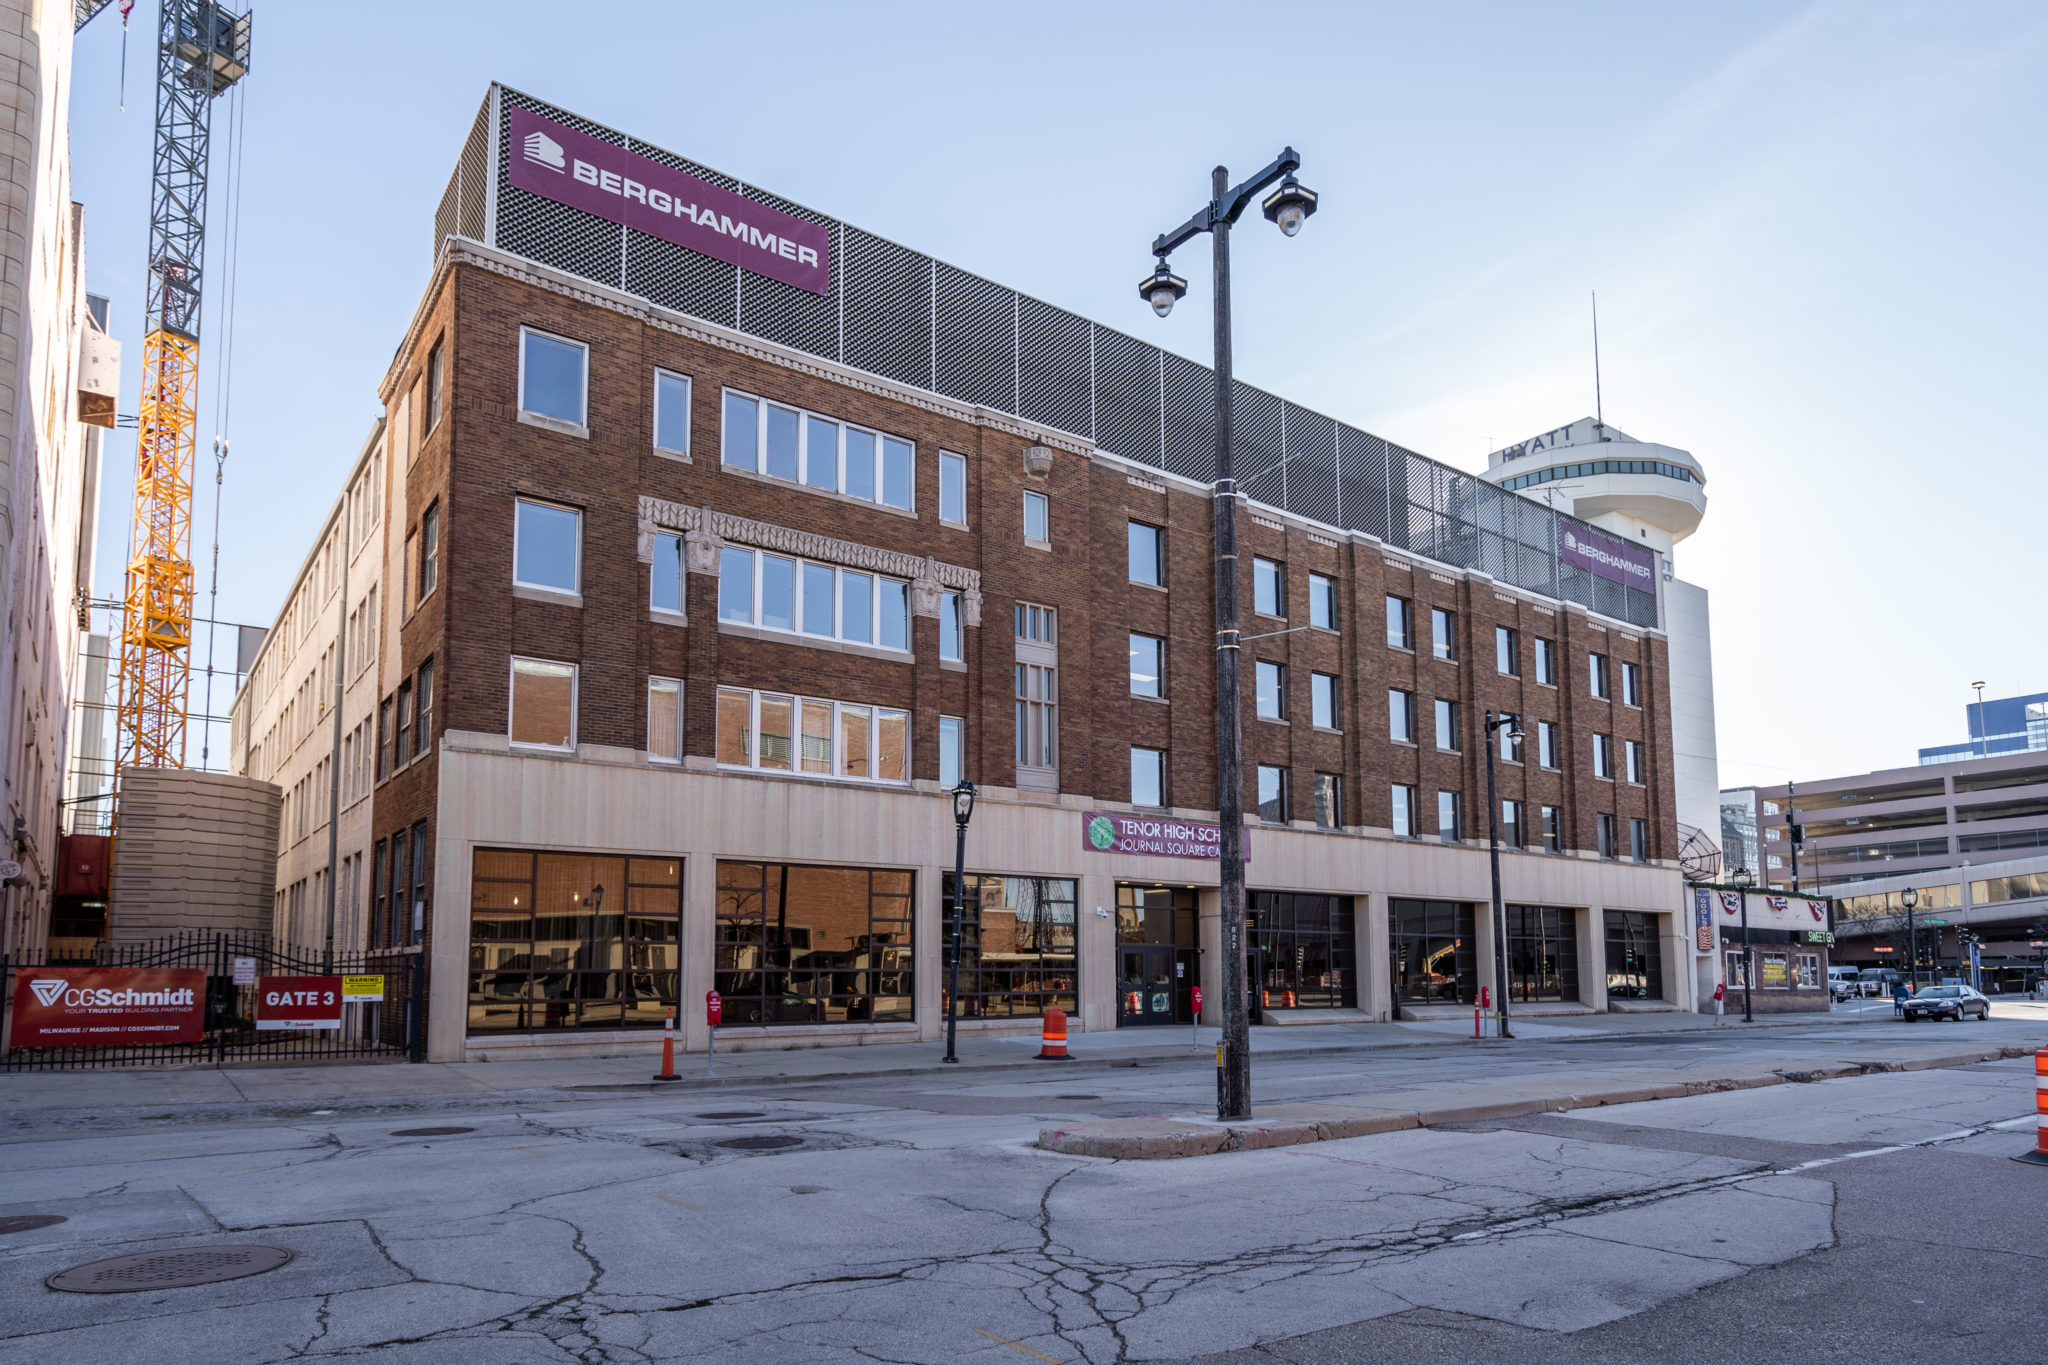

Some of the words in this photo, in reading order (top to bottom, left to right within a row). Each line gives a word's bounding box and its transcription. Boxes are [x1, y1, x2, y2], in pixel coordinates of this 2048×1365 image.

[573, 158, 818, 268] BERGHAMMER
[1502, 424, 1573, 463] HYATT
[1577, 542, 1651, 579] BERGHAMMER
[1120, 819, 1161, 838] TENOR
[1164, 824, 1195, 841] HIGH
[1198, 827, 1220, 843] SCH
[1119, 838, 1165, 855] JOURNAL
[1167, 843, 1206, 857] SQUARE
[1207, 845, 1220, 857] CA
[1808, 930, 1826, 943] SWEET
[64, 988, 194, 1007] CGSchmidt
[266, 991, 319, 1006] GATE
[323, 991, 335, 1006] 3
